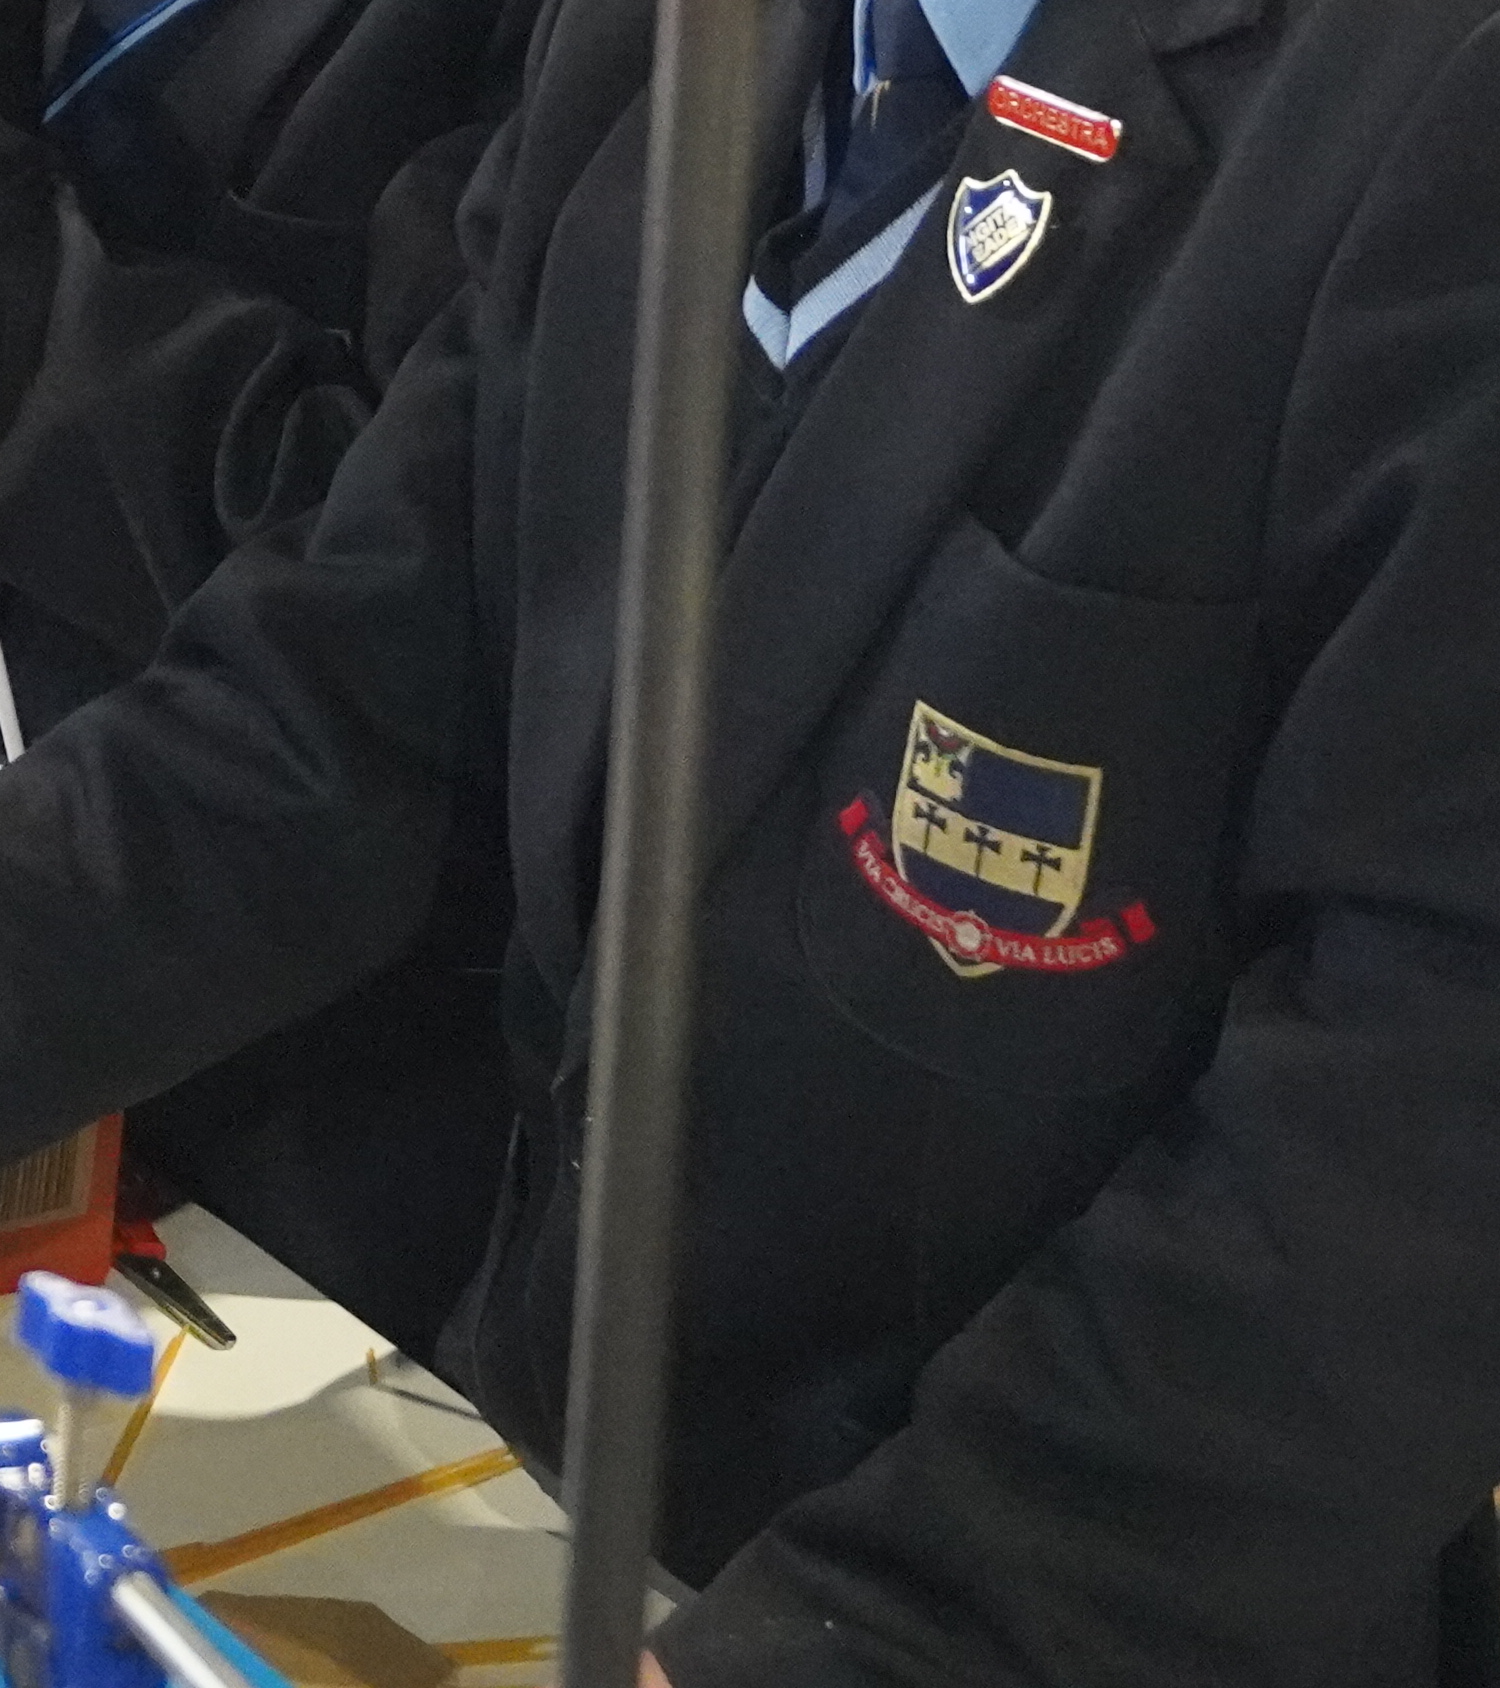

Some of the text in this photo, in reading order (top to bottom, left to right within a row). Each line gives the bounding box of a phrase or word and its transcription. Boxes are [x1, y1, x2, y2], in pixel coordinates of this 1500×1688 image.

[995, 85, 1108, 150] ORCHESTRA
[857, 840, 882, 883] VIA
[995, 935, 1037, 962] VIA
[1042, 935, 1119, 965] LUCIS
